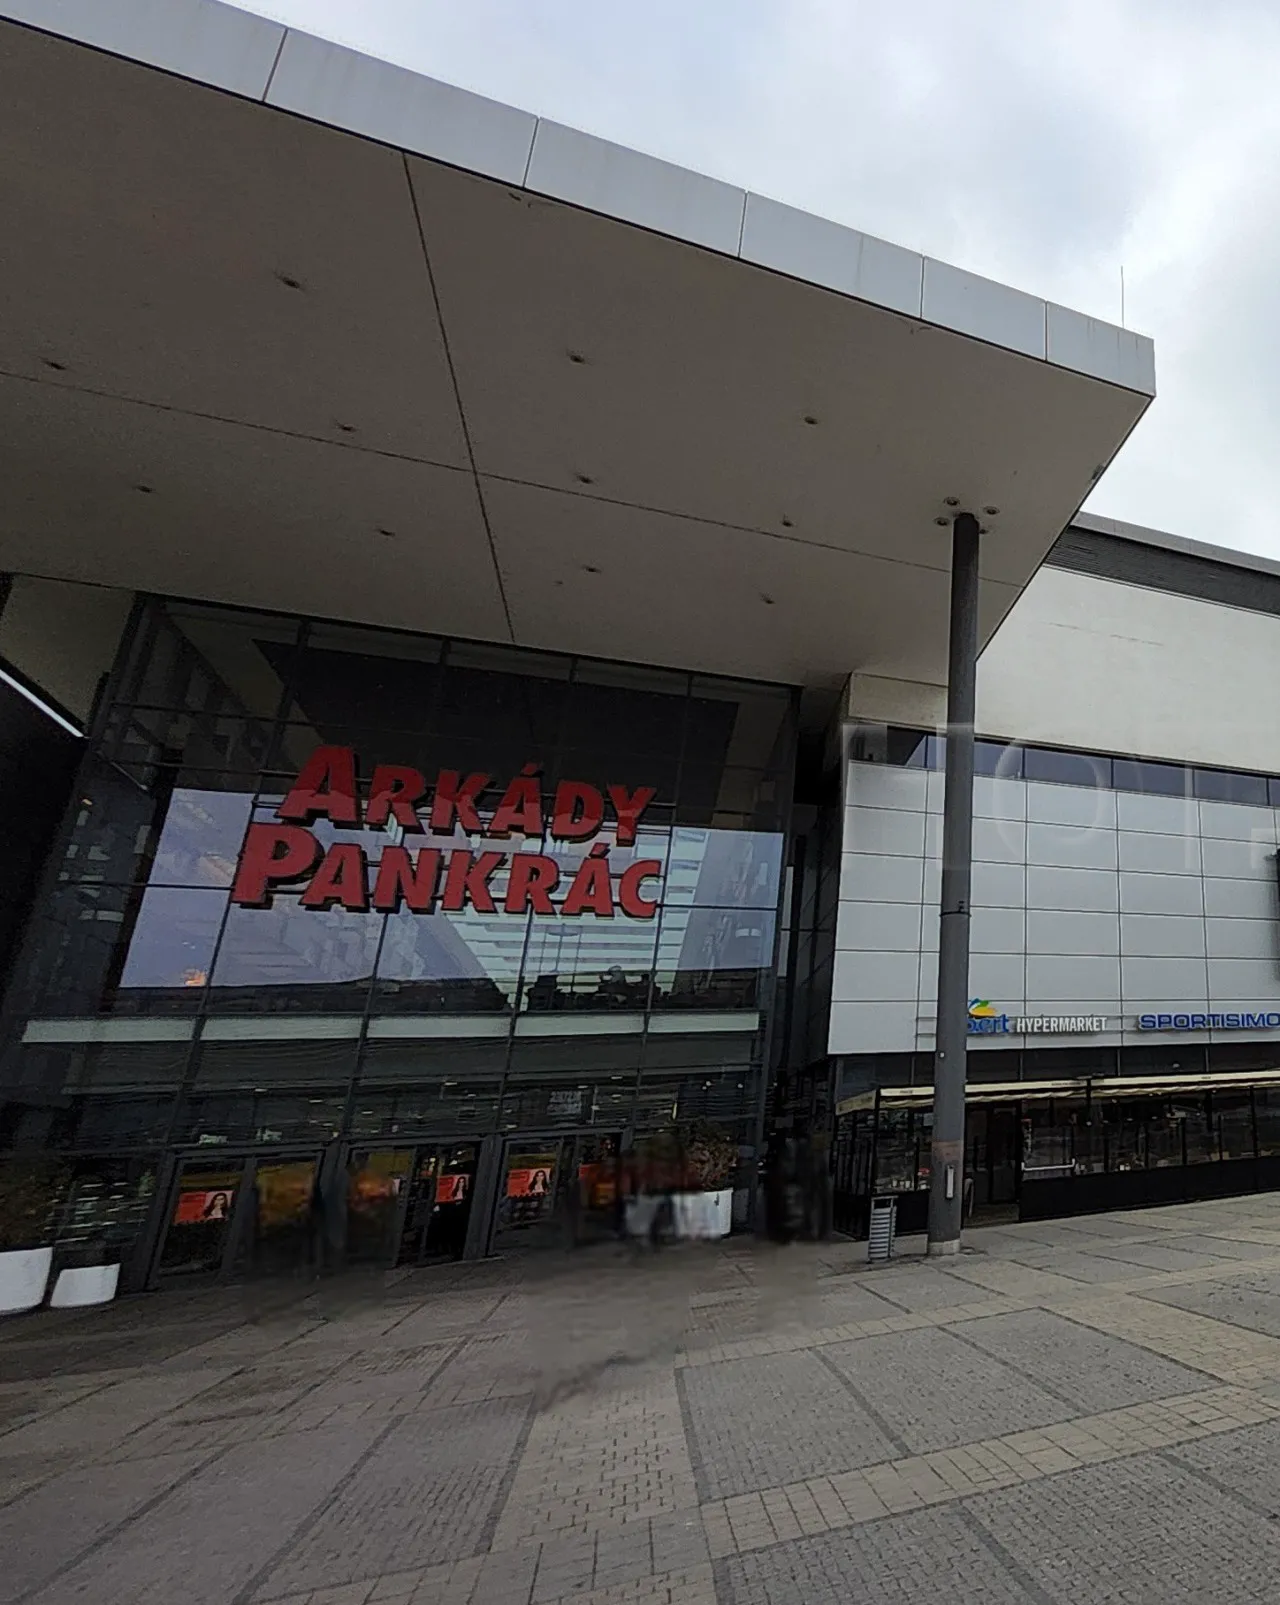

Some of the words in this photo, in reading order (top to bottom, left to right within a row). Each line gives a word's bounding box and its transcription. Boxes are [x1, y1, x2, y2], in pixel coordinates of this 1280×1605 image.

[277, 744, 657, 847] ARKÁDY
[232, 822, 662, 919] PANKRÁC
[1016, 1017, 1107, 1032] HYPERMARKET
